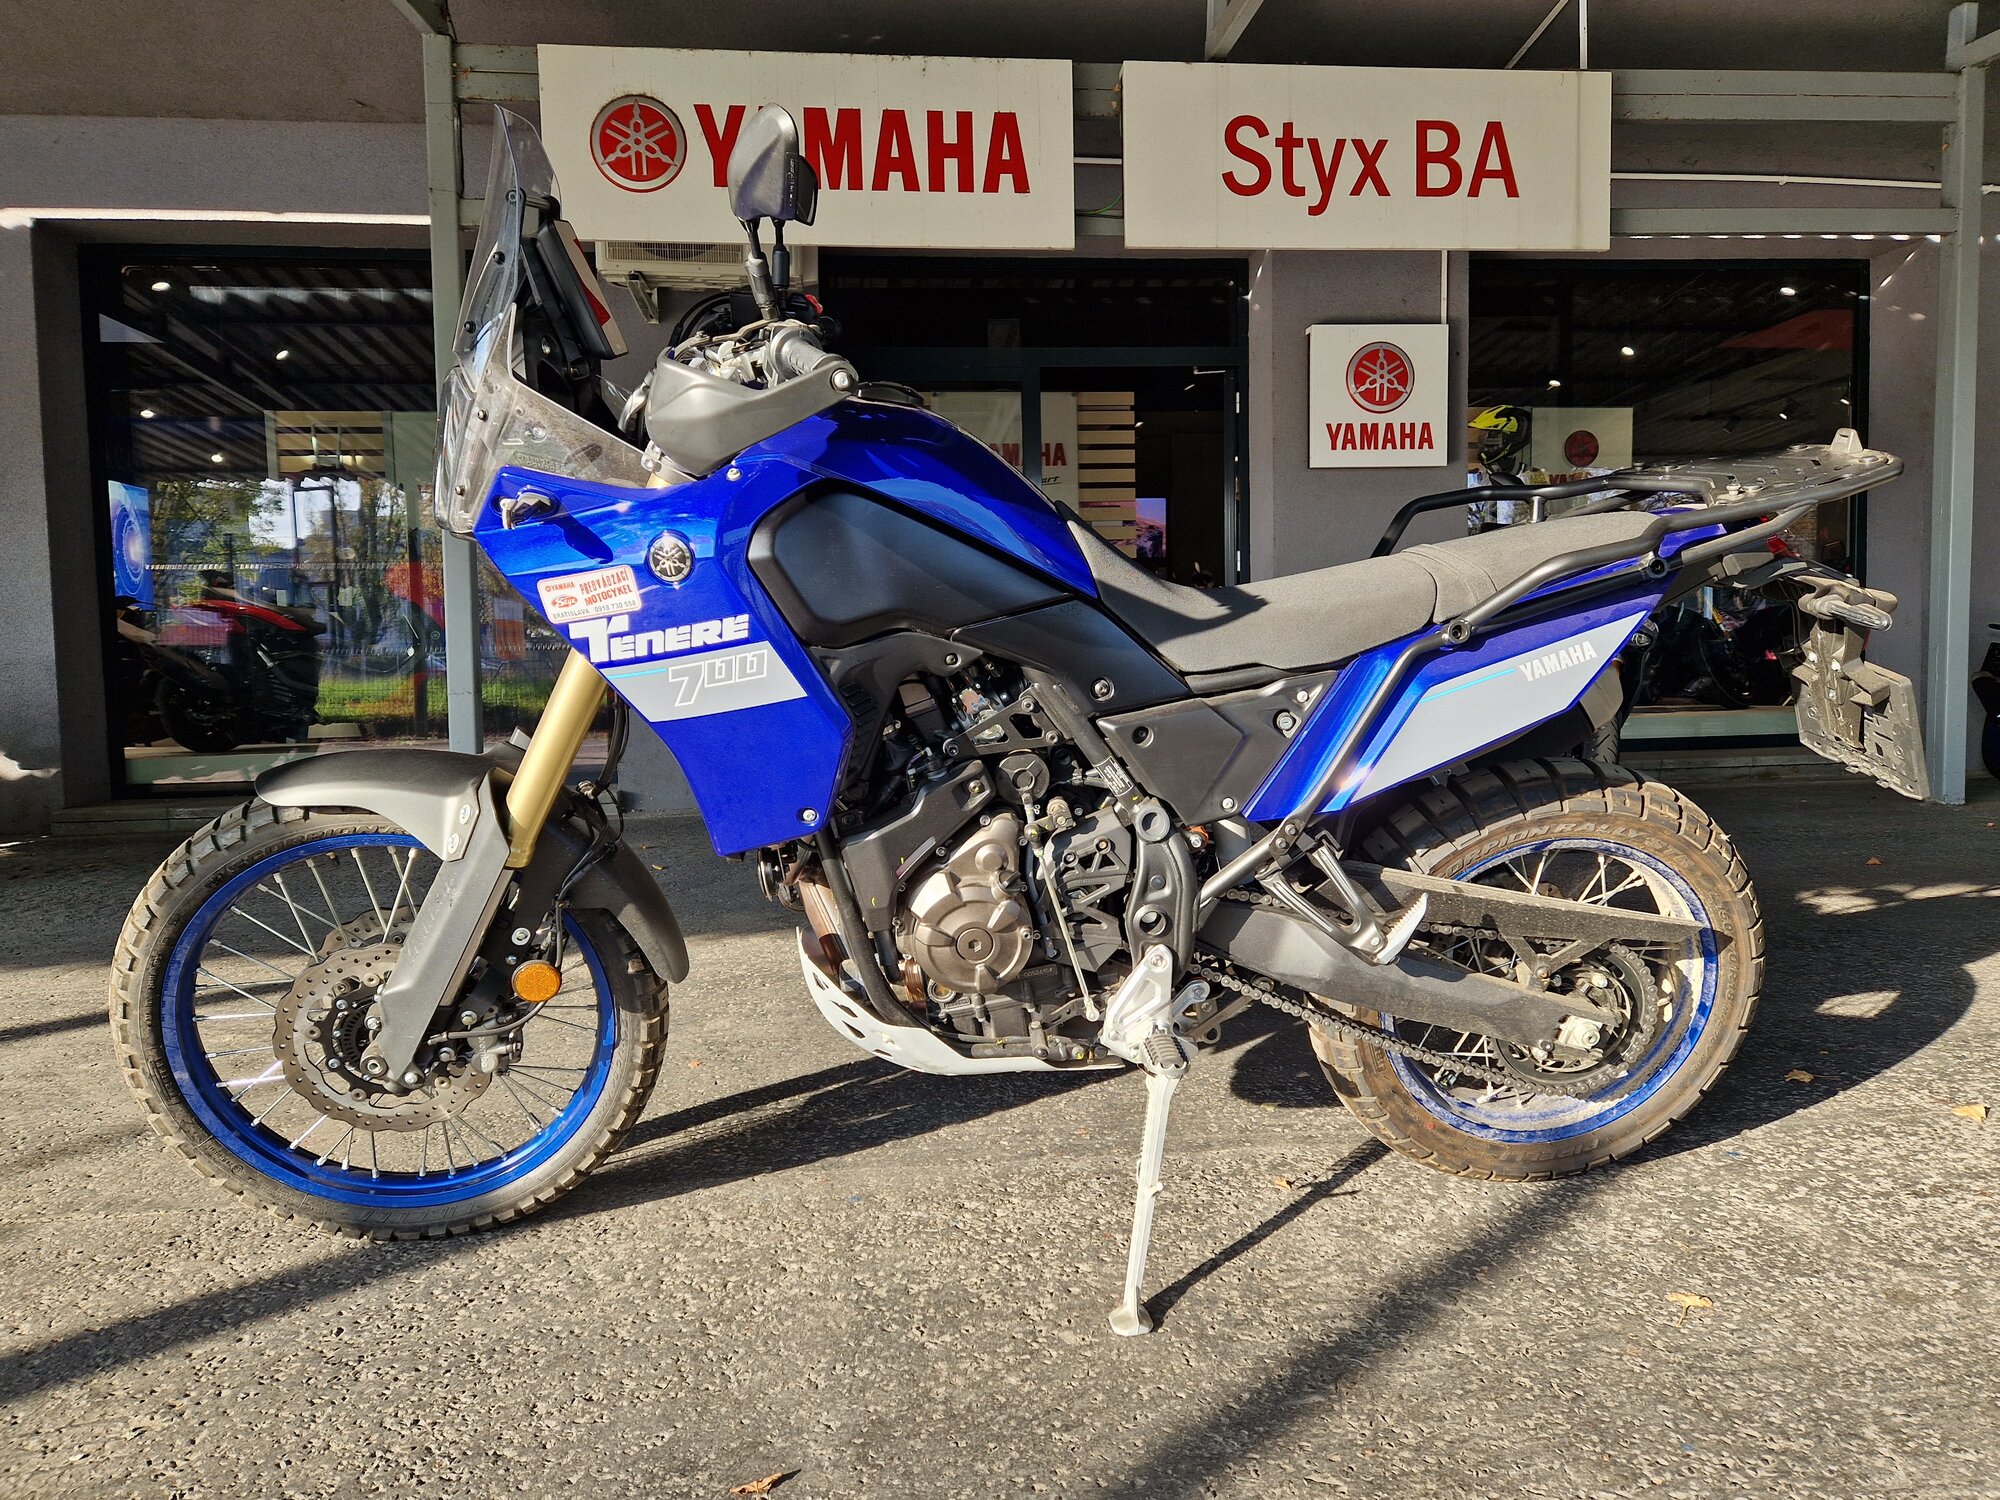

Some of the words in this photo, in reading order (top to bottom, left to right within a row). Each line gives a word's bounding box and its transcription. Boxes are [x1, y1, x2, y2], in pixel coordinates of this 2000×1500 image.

[693, 103, 1030, 194] YMAHA
[1221, 114, 1391, 216] Styx
[1415, 119, 1520, 198] BA
[1326, 422, 1434, 451] YAMAHA
[550, 581, 575, 592] YAMAHA
[584, 584, 633, 607] MOTOCYKEL
[552, 608, 591, 620] BRATISLAVA
[594, 604, 611, 613] 0918
[611, 601, 624, 610] 730
[668, 649, 768, 708] 700
[1518, 640, 1598, 682] YAMAHA
[1437, 824, 1551, 878] ORPION
[1554, 822, 1646, 840] RALLY
